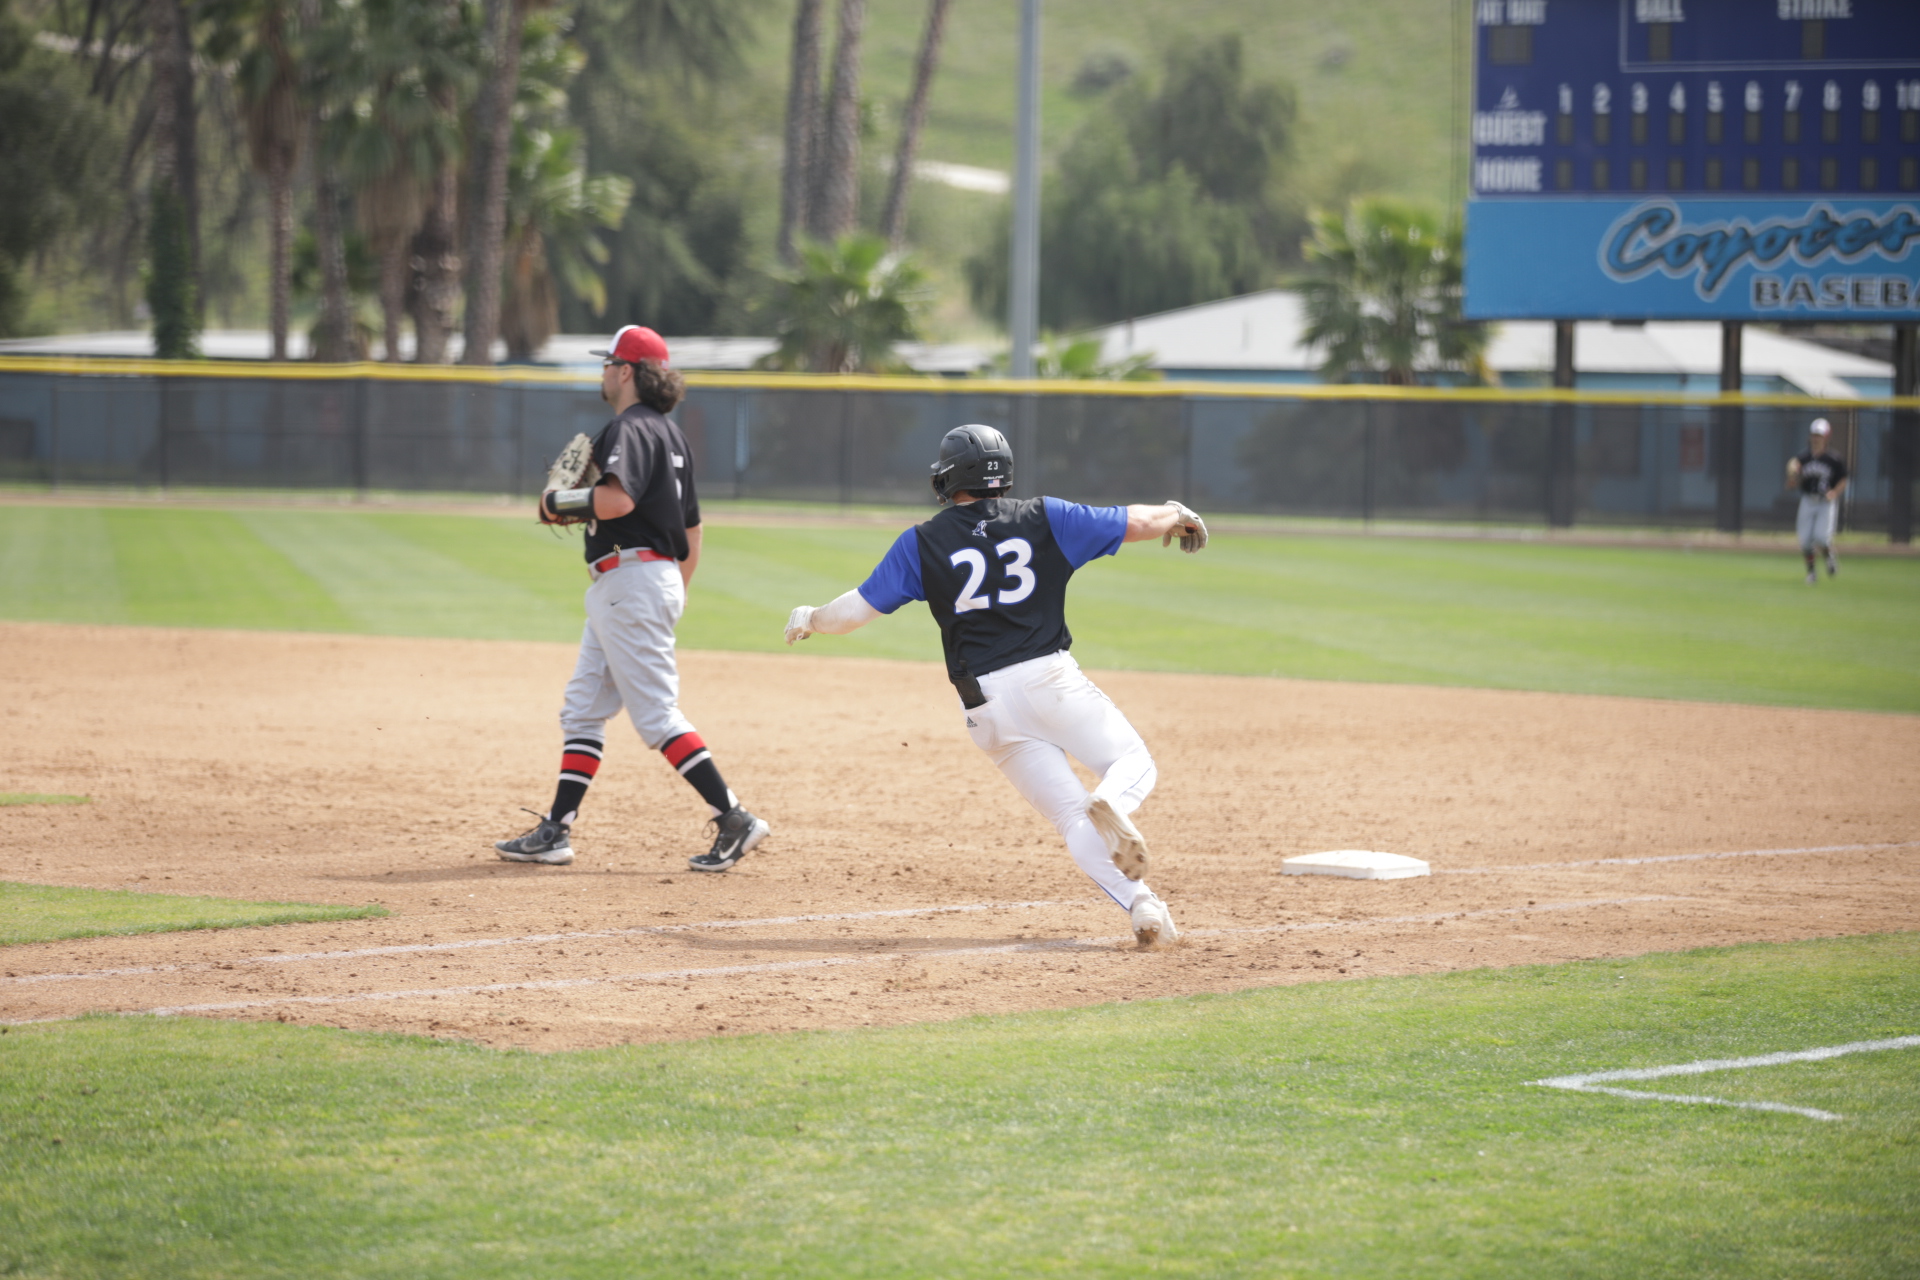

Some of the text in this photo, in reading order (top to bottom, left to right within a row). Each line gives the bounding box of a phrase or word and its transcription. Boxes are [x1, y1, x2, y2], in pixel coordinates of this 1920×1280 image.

[1558, 83, 1573, 115] 1
[1593, 82, 1611, 115] 2
[1631, 81, 1649, 114] 3
[1669, 81, 1686, 113] 4
[1707, 81, 1724, 113] 5
[1744, 80, 1763, 112] 6
[1784, 80, 1802, 112] 7
[1823, 79, 1841, 111] 8
[1862, 79, 1881, 111] 9
[1473, 110, 1547, 146] GUEST
[1475, 156, 1543, 192] HOME
[1599, 199, 1920, 304] Coyotes
[987, 461, 999, 471] 23
[950, 536, 1037, 615] 23
